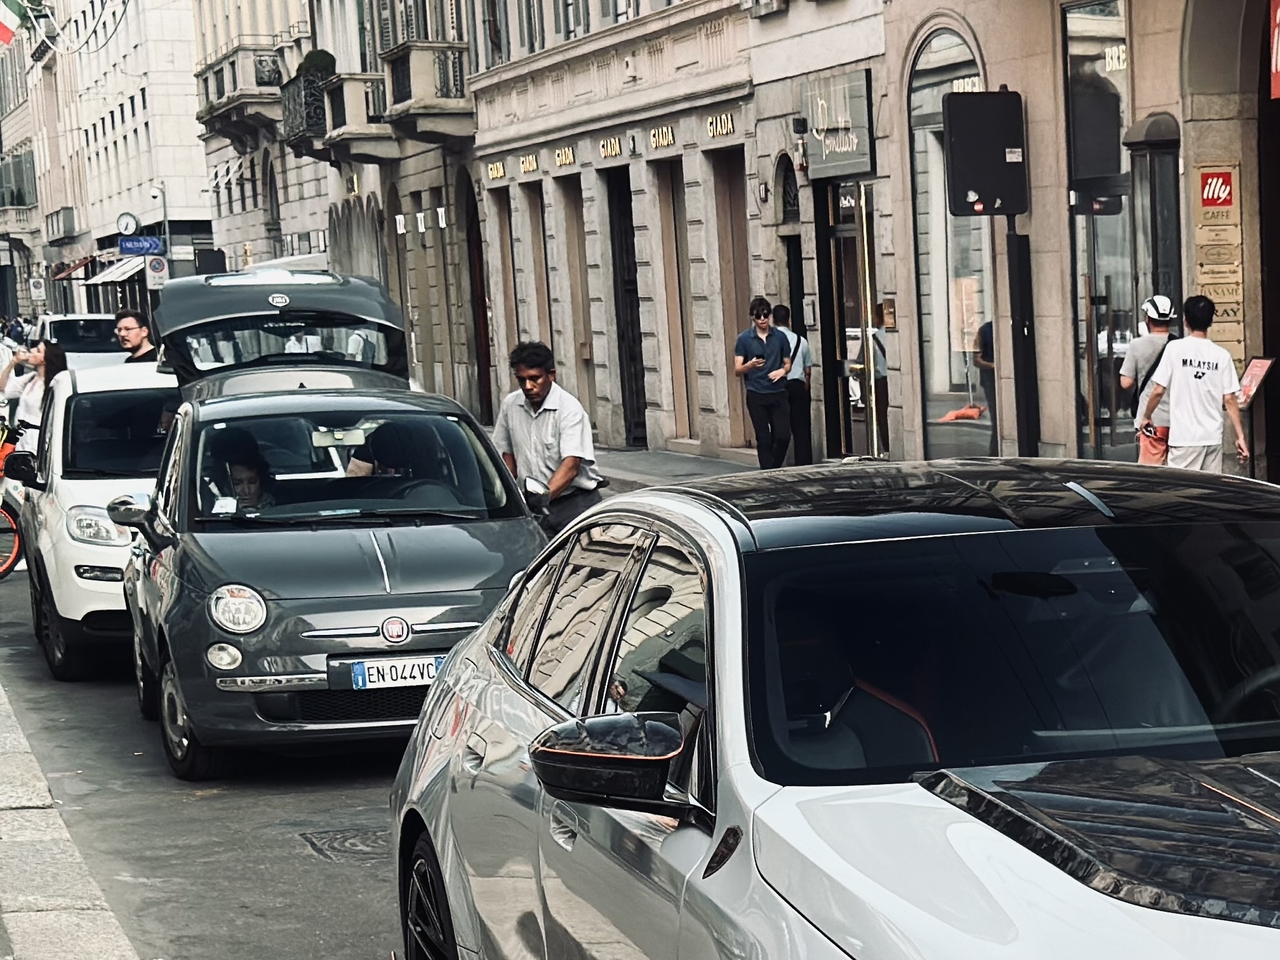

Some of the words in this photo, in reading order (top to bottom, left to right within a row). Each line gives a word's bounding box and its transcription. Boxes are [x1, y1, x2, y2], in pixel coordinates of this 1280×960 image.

[707, 113, 735, 138] GIADA
[600, 137, 622, 159] GIADA
[650, 126, 676, 149] GIADA
[555, 147, 575, 167] GIADA
[1203, 177, 1231, 204] illy
[1181, 358, 1219, 372] MALAYSIA
[367, 665, 386, 684] EN
